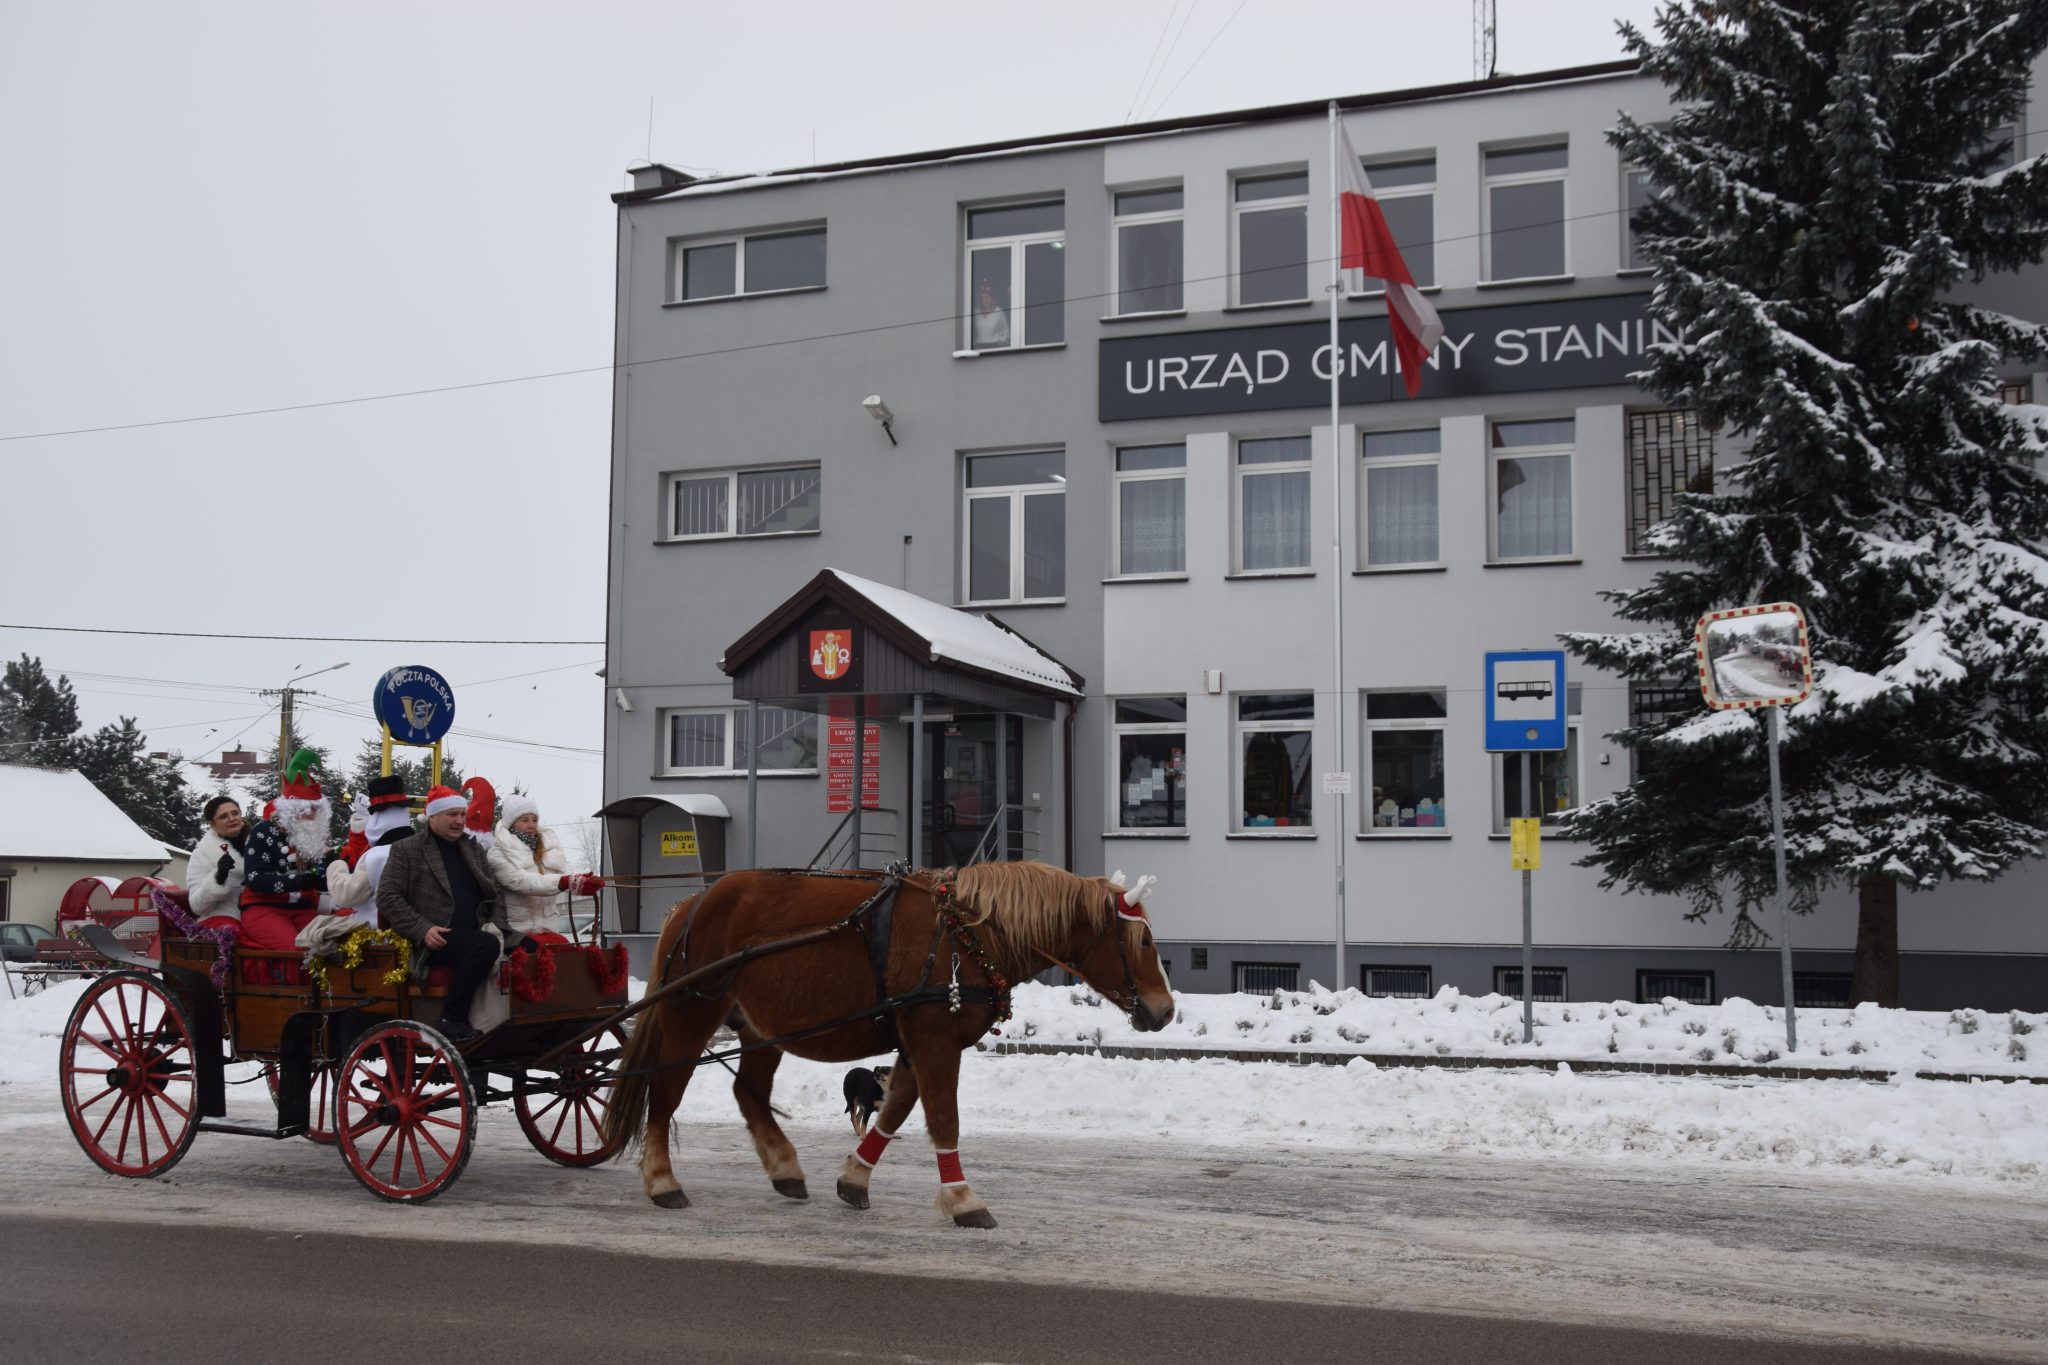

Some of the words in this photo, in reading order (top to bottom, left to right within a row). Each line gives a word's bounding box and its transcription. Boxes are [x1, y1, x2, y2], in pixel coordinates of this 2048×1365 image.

[1126, 350, 1289, 394] URZĄD
[1494, 318, 1684, 366] STANIN
[388, 671, 423, 693] POCZTA
[425, 674, 452, 711] POLSKA
